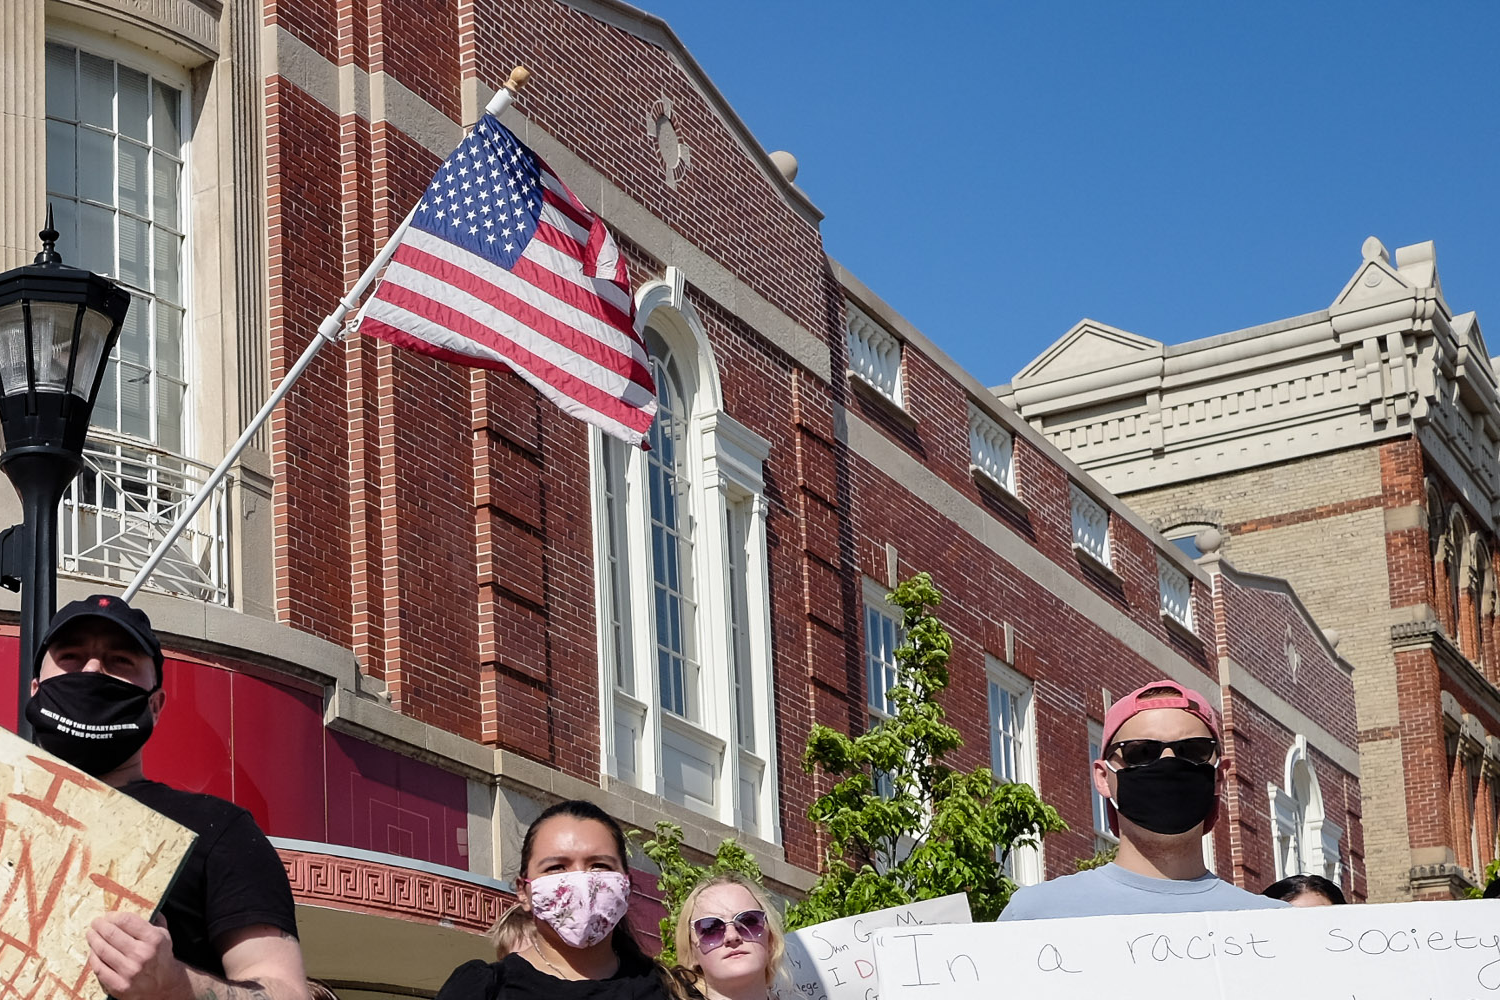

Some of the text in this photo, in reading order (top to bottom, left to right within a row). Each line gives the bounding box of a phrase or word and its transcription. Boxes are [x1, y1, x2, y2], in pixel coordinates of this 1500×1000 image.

[7, 754, 108, 830] I
[812, 929, 850, 961] Skin
[1037, 942, 1083, 974] a
[1127, 928, 1276, 963] racist
[828, 966, 847, 987] I
